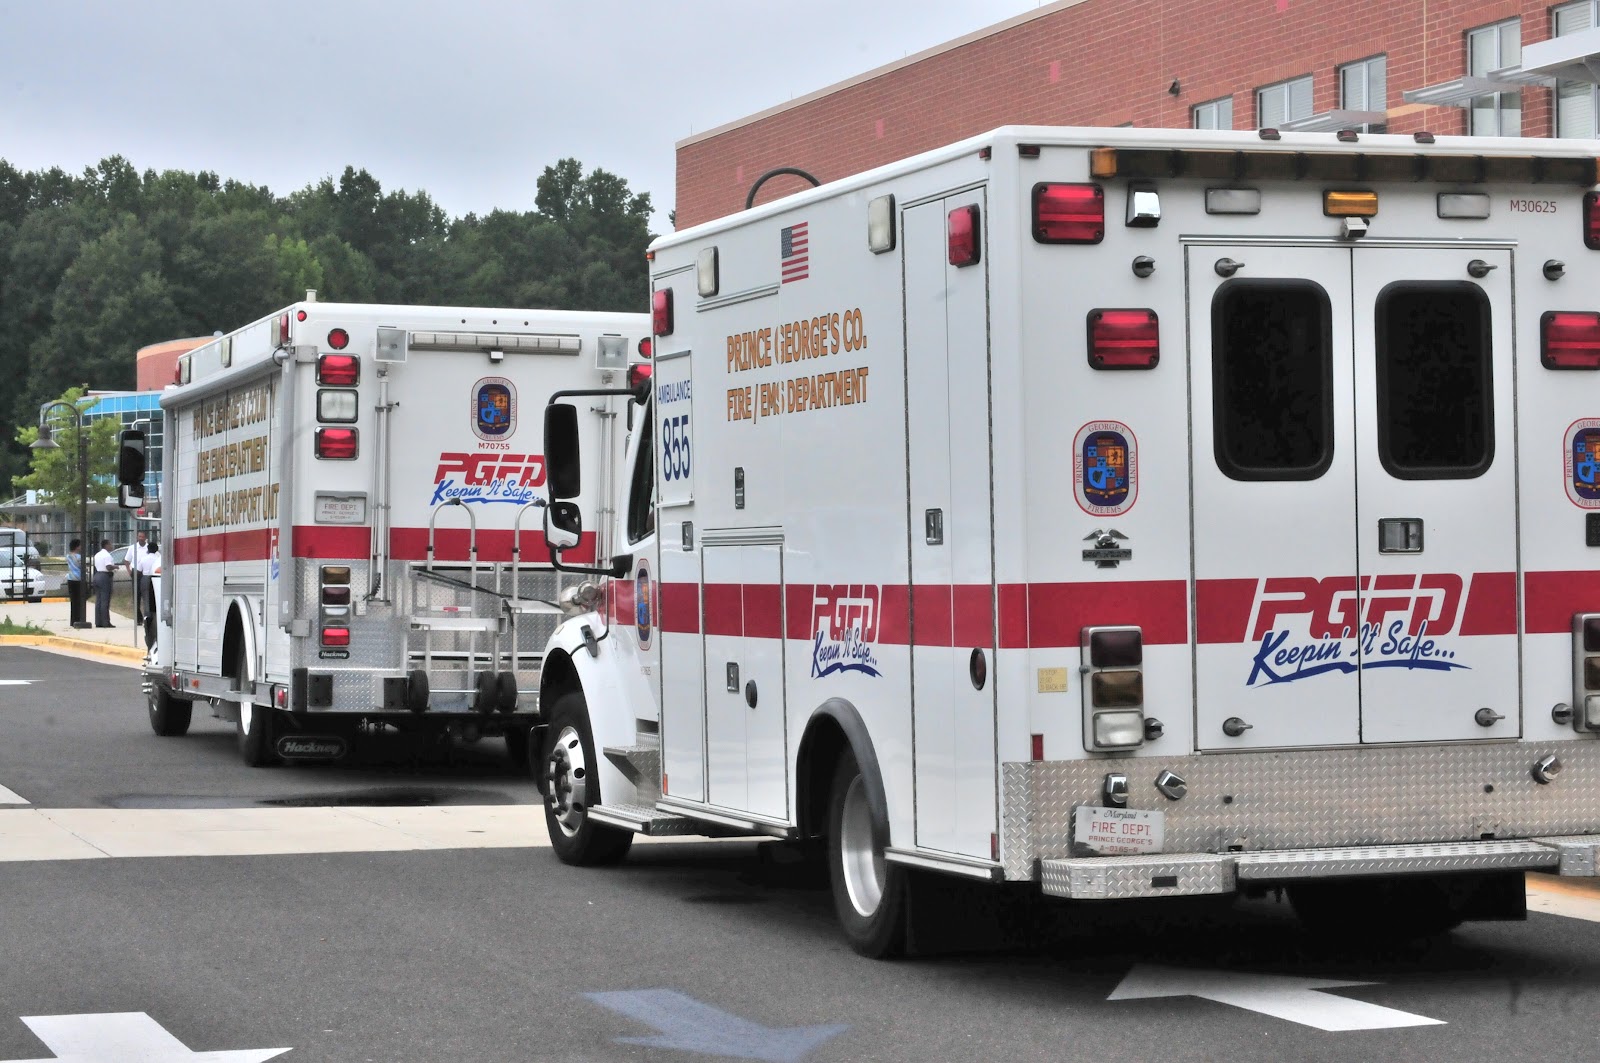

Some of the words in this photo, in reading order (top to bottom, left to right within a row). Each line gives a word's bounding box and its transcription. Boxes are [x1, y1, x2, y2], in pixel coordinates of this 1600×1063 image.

[1510, 199, 1557, 214] M30625
[727, 327, 772, 374] PRINCE
[774, 312, 840, 365] GEORGE'S
[842, 307, 868, 353] CO.
[658, 379, 691, 405] AMBULANCE
[727, 386, 752, 422] FIRE
[760, 380, 785, 418] EMS
[787, 366, 869, 414] DEPARTMENT
[1088, 423, 1126, 434] GEORGE'S
[478, 442, 510, 450] M70755
[663, 414, 690, 482] 855
[433, 452, 547, 488] PGFD
[1075, 452, 1083, 484] PRINCE
[502, 478, 541, 502] Safe..
[1087, 503, 1122, 514] FIRE/EMS
[812, 583, 880, 643] PGFD
[1252, 572, 1464, 642] PGFD
[320, 651, 348, 659] Hackney
[1246, 626, 1352, 688] Keepin'
[1380, 619, 1456, 669] Safe...
[284, 741, 340, 754] Hackney
[1103, 809, 1138, 821] Maryland
[1091, 821, 1117, 834] FIRE
[1088, 835, 1115, 843] PRINCE
[1116, 836, 1153, 846] GEORGE'S
